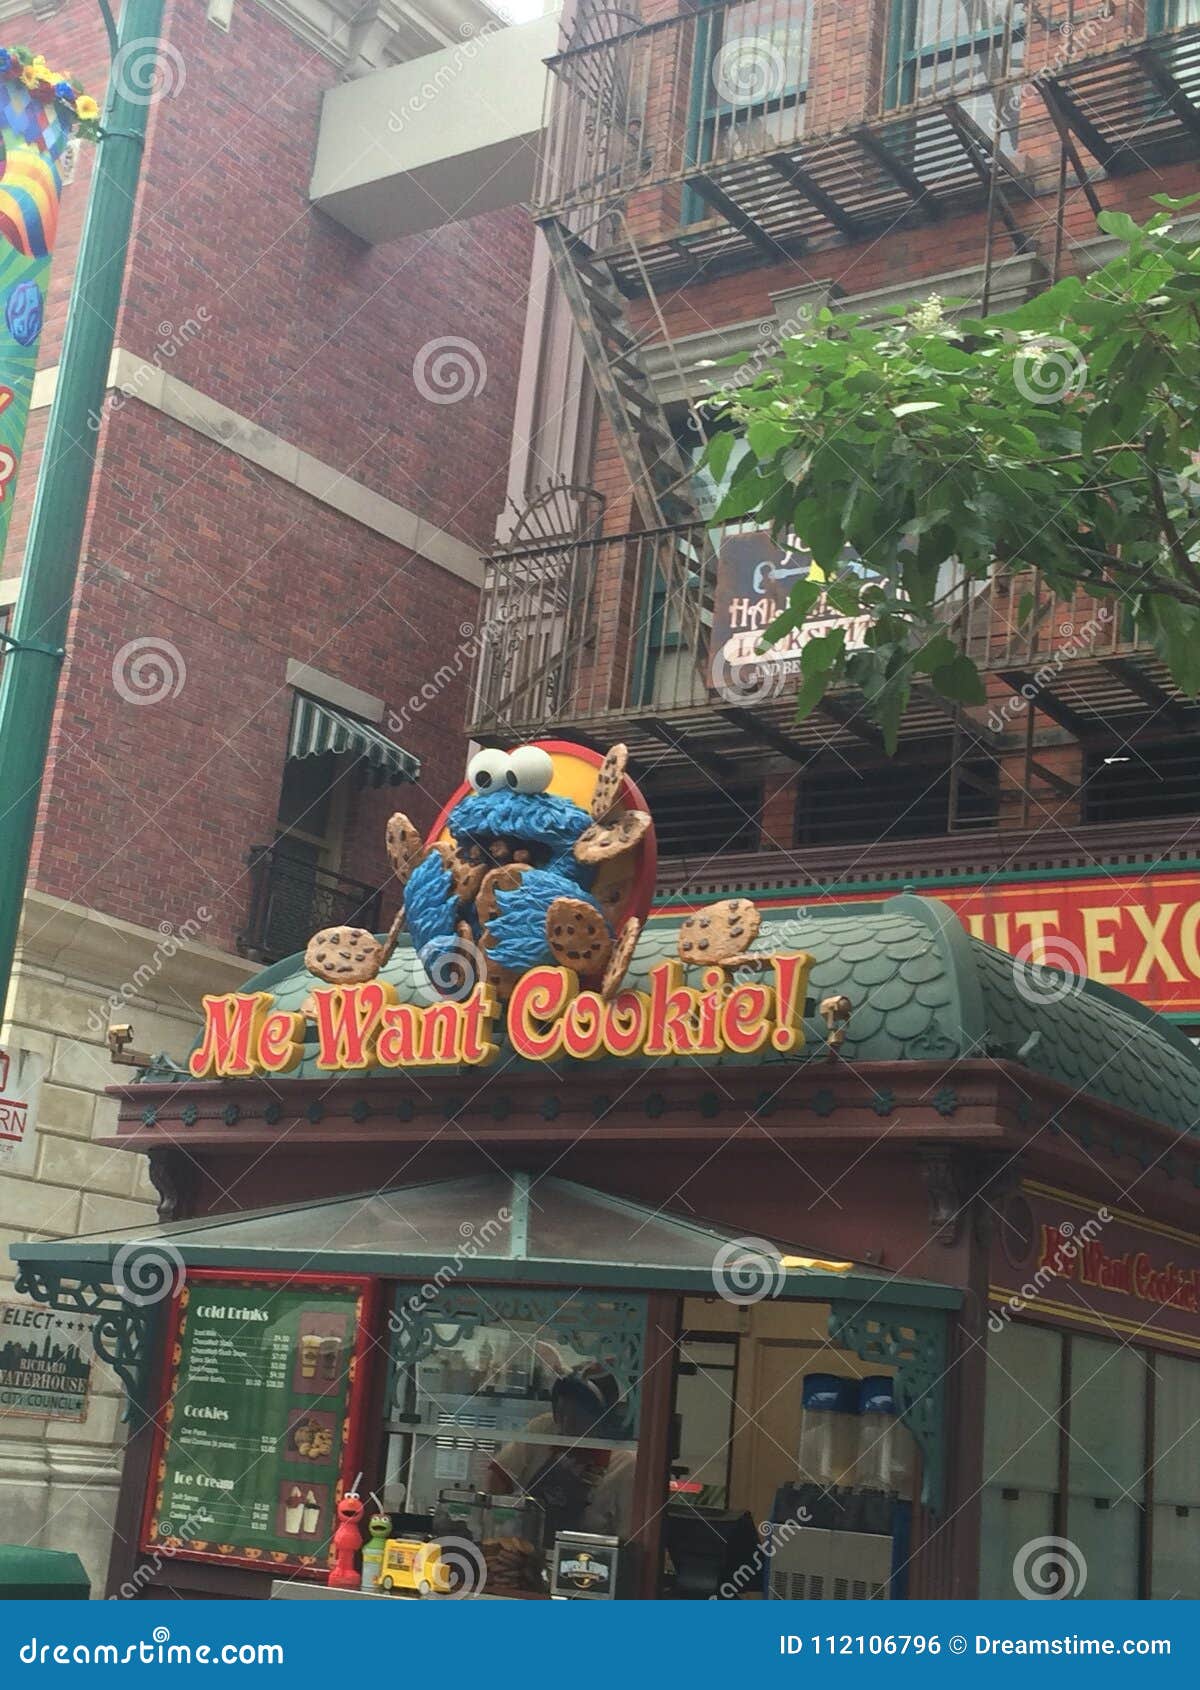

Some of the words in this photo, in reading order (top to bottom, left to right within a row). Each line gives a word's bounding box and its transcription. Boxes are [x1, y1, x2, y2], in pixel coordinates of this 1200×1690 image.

[753, 664, 780, 679] AND
[189, 993, 304, 1077] Me
[312, 982, 494, 1070] Want
[507, 953, 810, 1060] Cookie!
[3, 1308, 55, 1329] ELECT
[197, 1305, 225, 1319] Cold
[228, 1307, 269, 1321] Drinks
[20, 1358, 67, 1374] RICHARD
[1, 1391, 24, 1405] CITY
[27, 1394, 74, 1410] COUNCIL
[184, 1404, 229, 1421] Cookies
[173, 1471, 193, 1485] Ice
[196, 1474, 235, 1491] Cream
